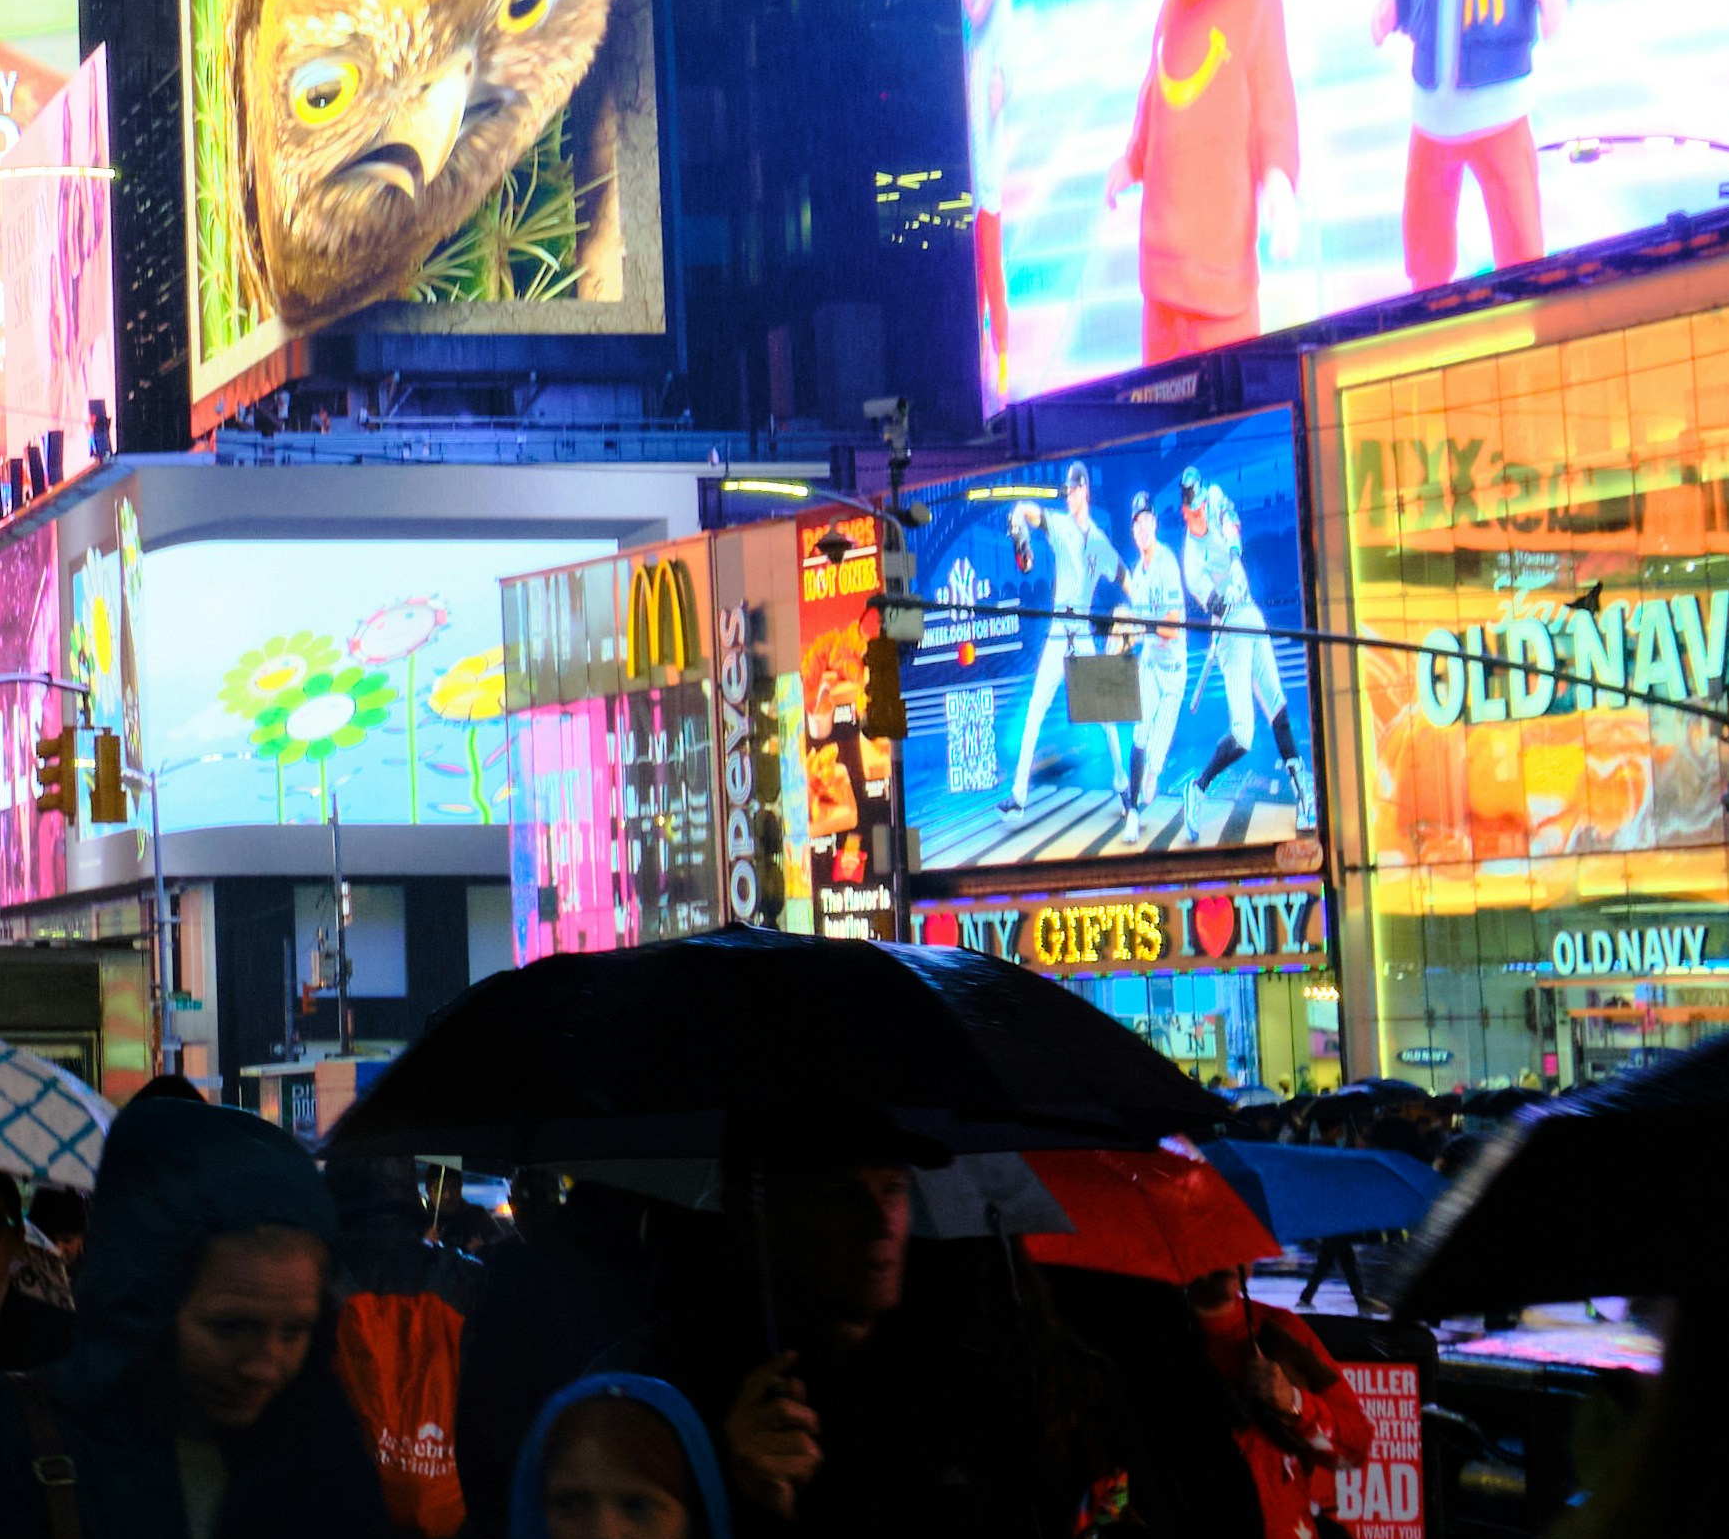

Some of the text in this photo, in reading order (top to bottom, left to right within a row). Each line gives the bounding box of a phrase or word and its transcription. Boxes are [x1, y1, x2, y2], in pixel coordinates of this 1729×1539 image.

[1417, 618, 1557, 728] OLD
[821, 889, 843, 915] The
[844, 887, 879, 912] flavor
[1033, 902, 1162, 965] GIFTS
[1176, 897, 1196, 957] I
[1235, 890, 1312, 955] NY.
[1553, 925, 1707, 977] OLD NAVY
[1399, 1398, 1417, 1419] BE
[1371, 1440, 1423, 1461] ETHIN'
[1335, 1463, 1419, 1522] BAD
